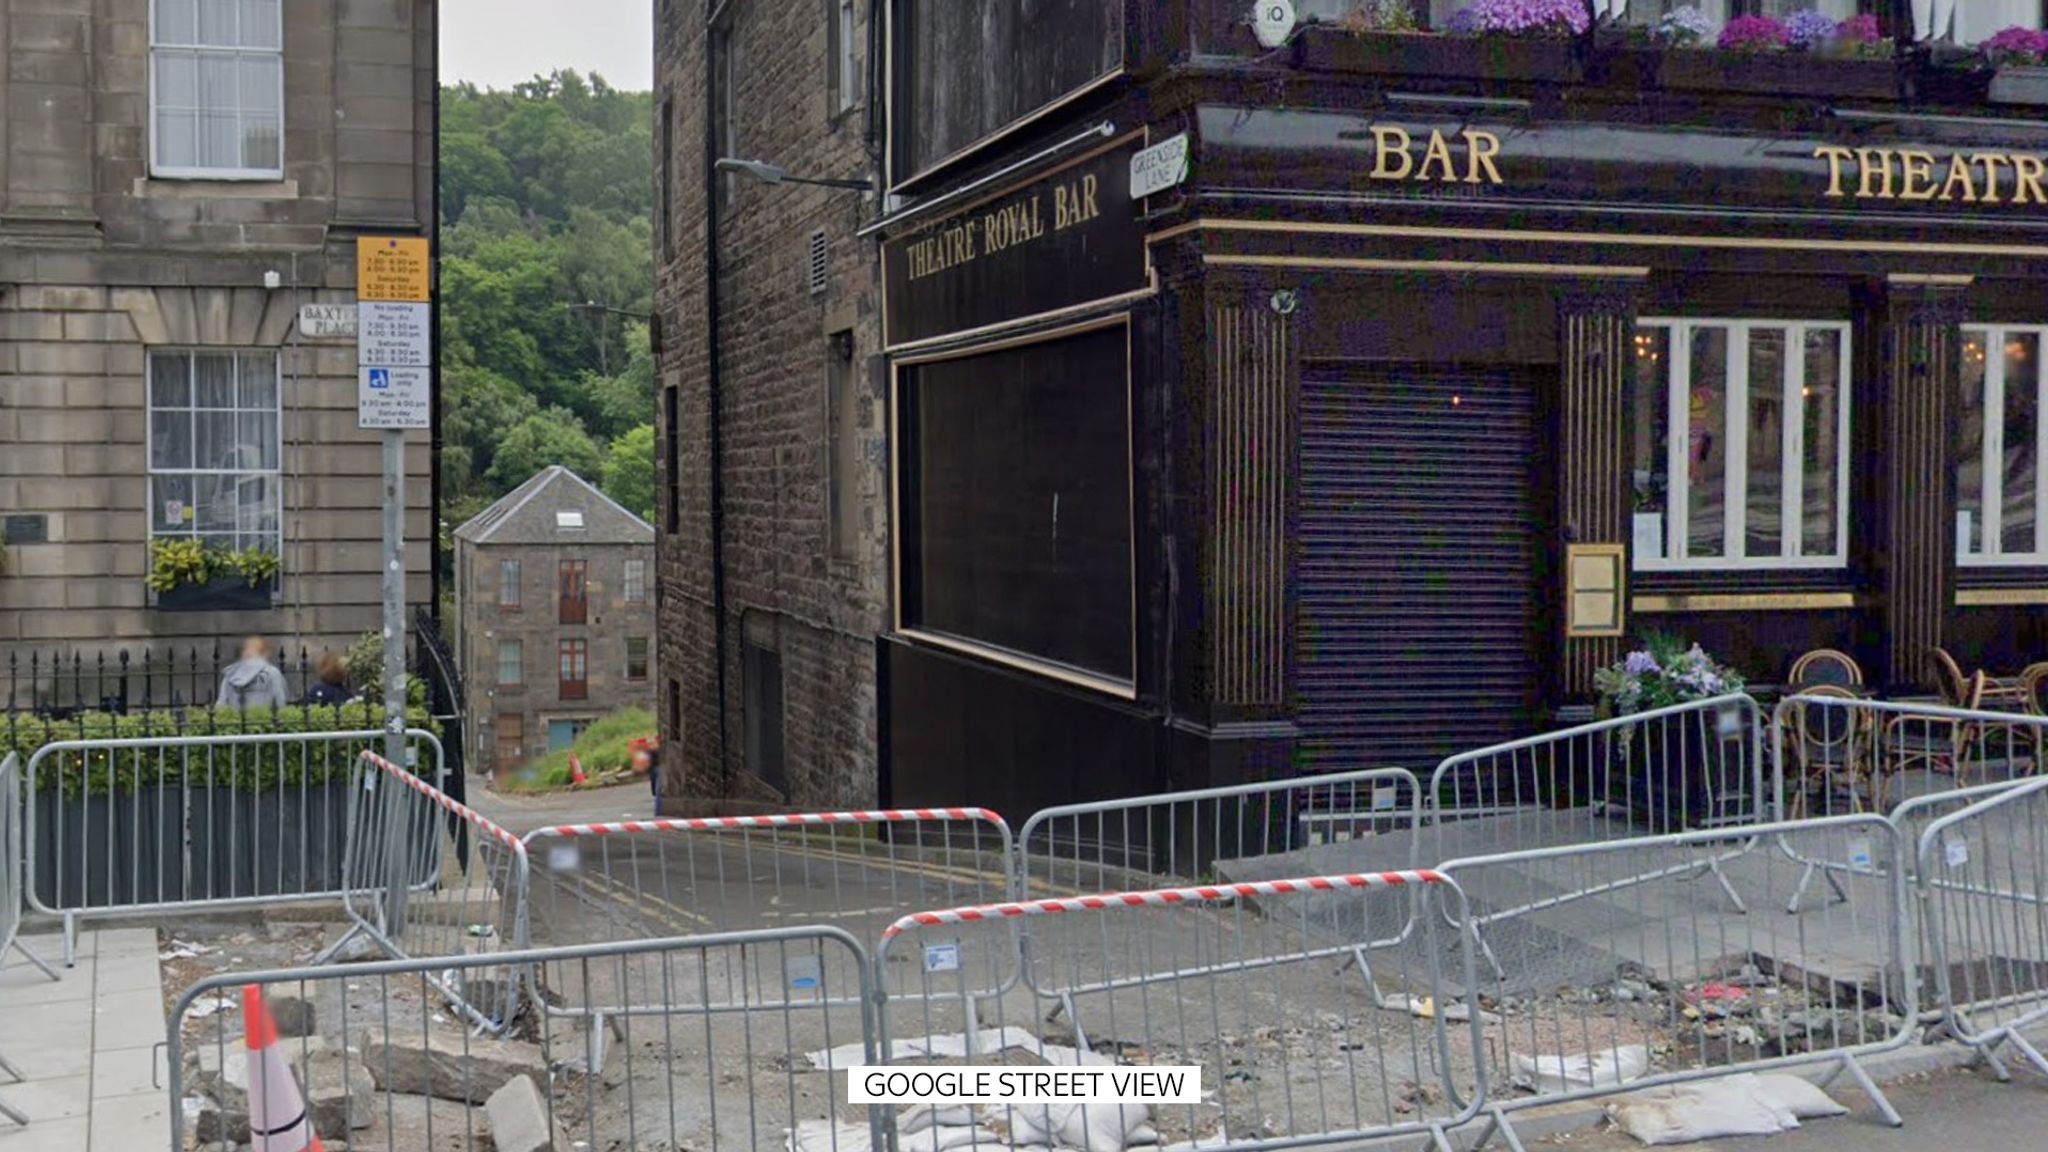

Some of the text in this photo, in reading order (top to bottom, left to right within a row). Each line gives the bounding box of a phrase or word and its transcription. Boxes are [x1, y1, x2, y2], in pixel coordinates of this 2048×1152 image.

[1134, 138, 1184, 175] GREENSIDE
[1145, 163, 1172, 190] LANE
[1369, 125, 1503, 185] BAR
[1813, 146, 2048, 204] THEATR
[906, 220, 977, 281] THEATRE
[984, 195, 1045, 256] ROYAL
[1054, 172, 1101, 231] BAR
[390, 371, 419, 380] Loading
